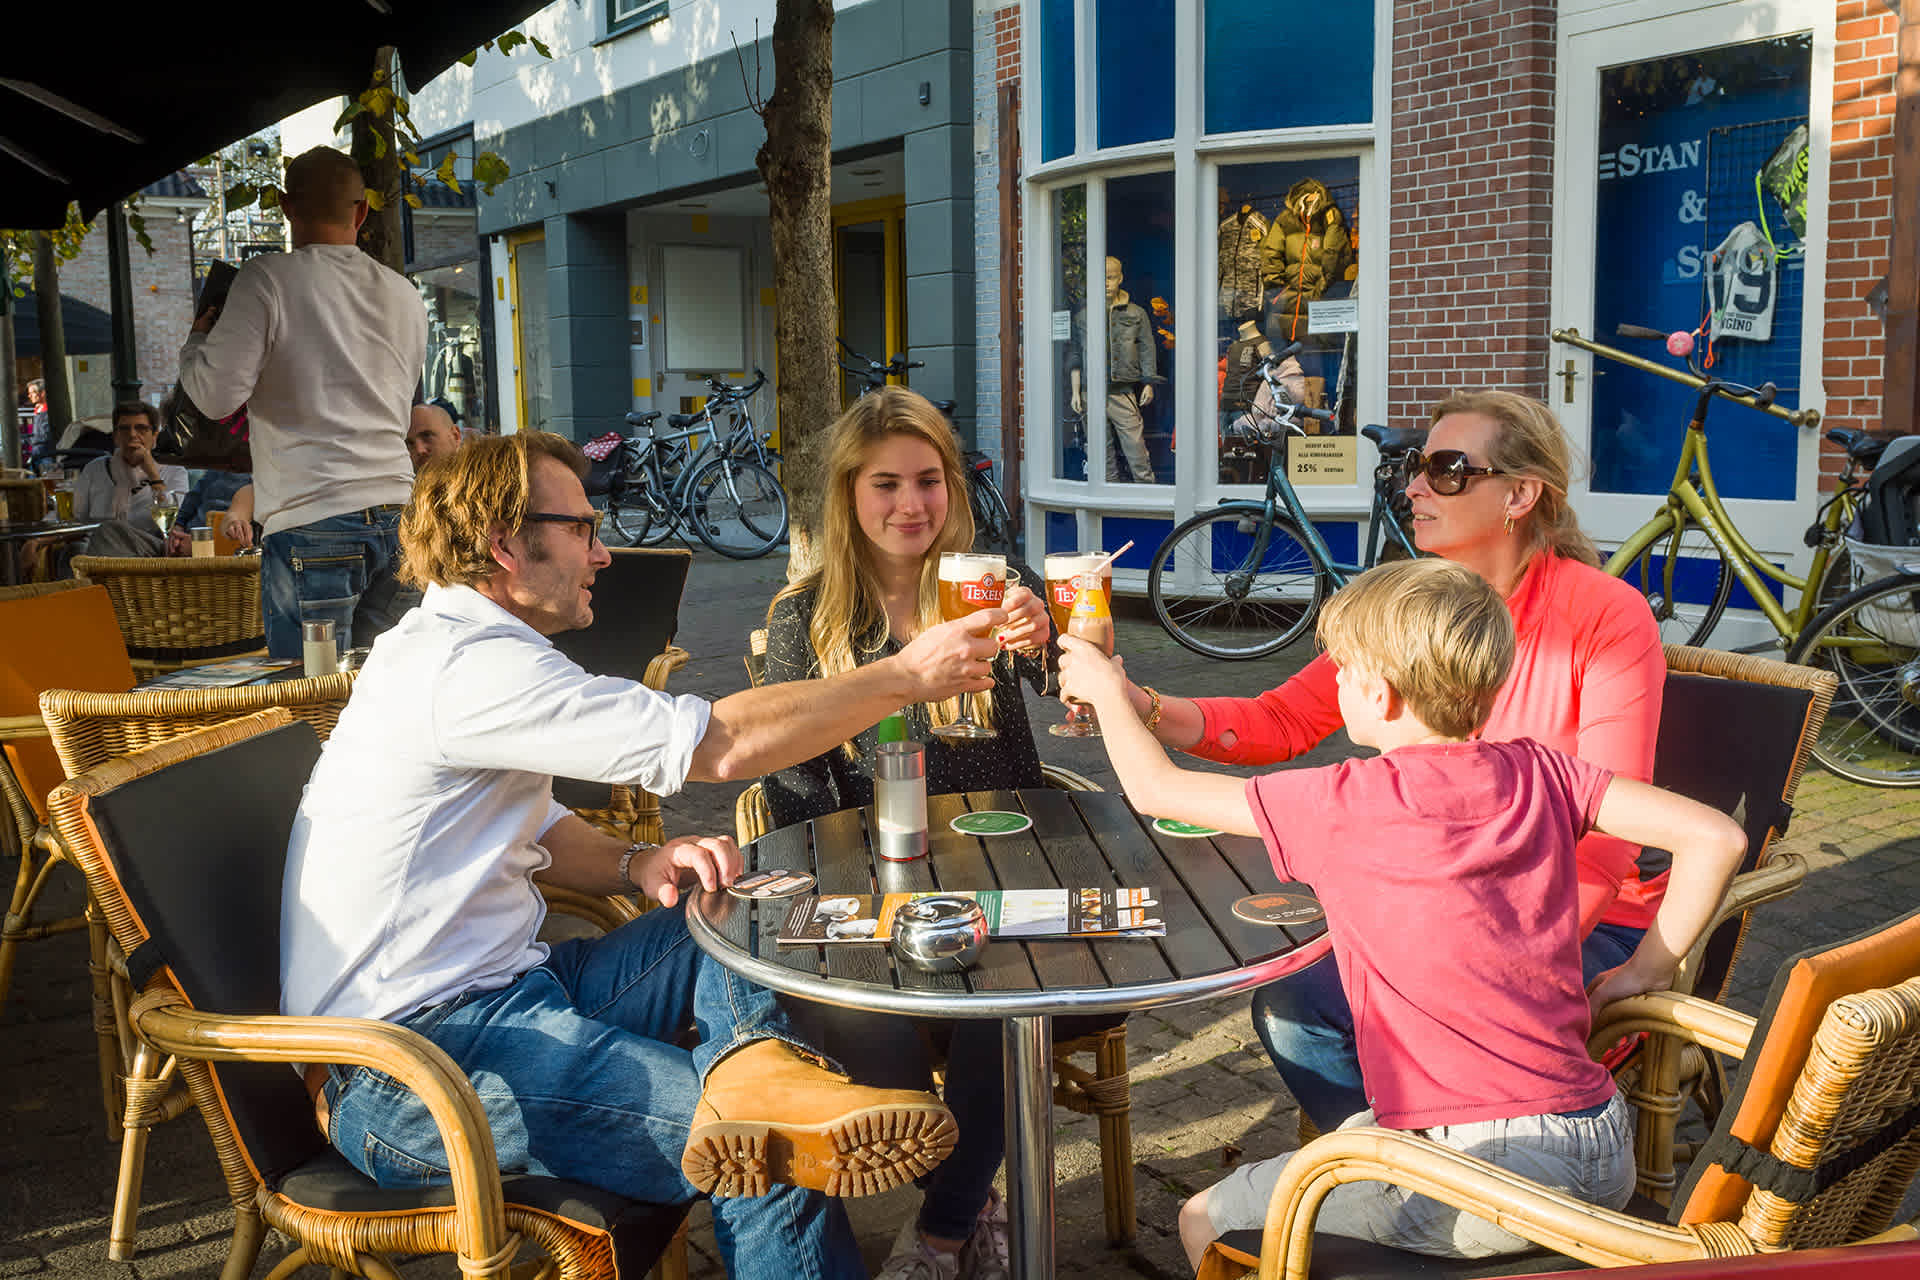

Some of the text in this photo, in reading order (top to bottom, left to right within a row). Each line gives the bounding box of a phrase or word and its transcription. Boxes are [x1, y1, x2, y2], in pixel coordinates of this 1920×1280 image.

[1618, 139, 1702, 177] STAN
[1678, 189, 1707, 224] &
[1297, 463, 1317, 473] 25%
